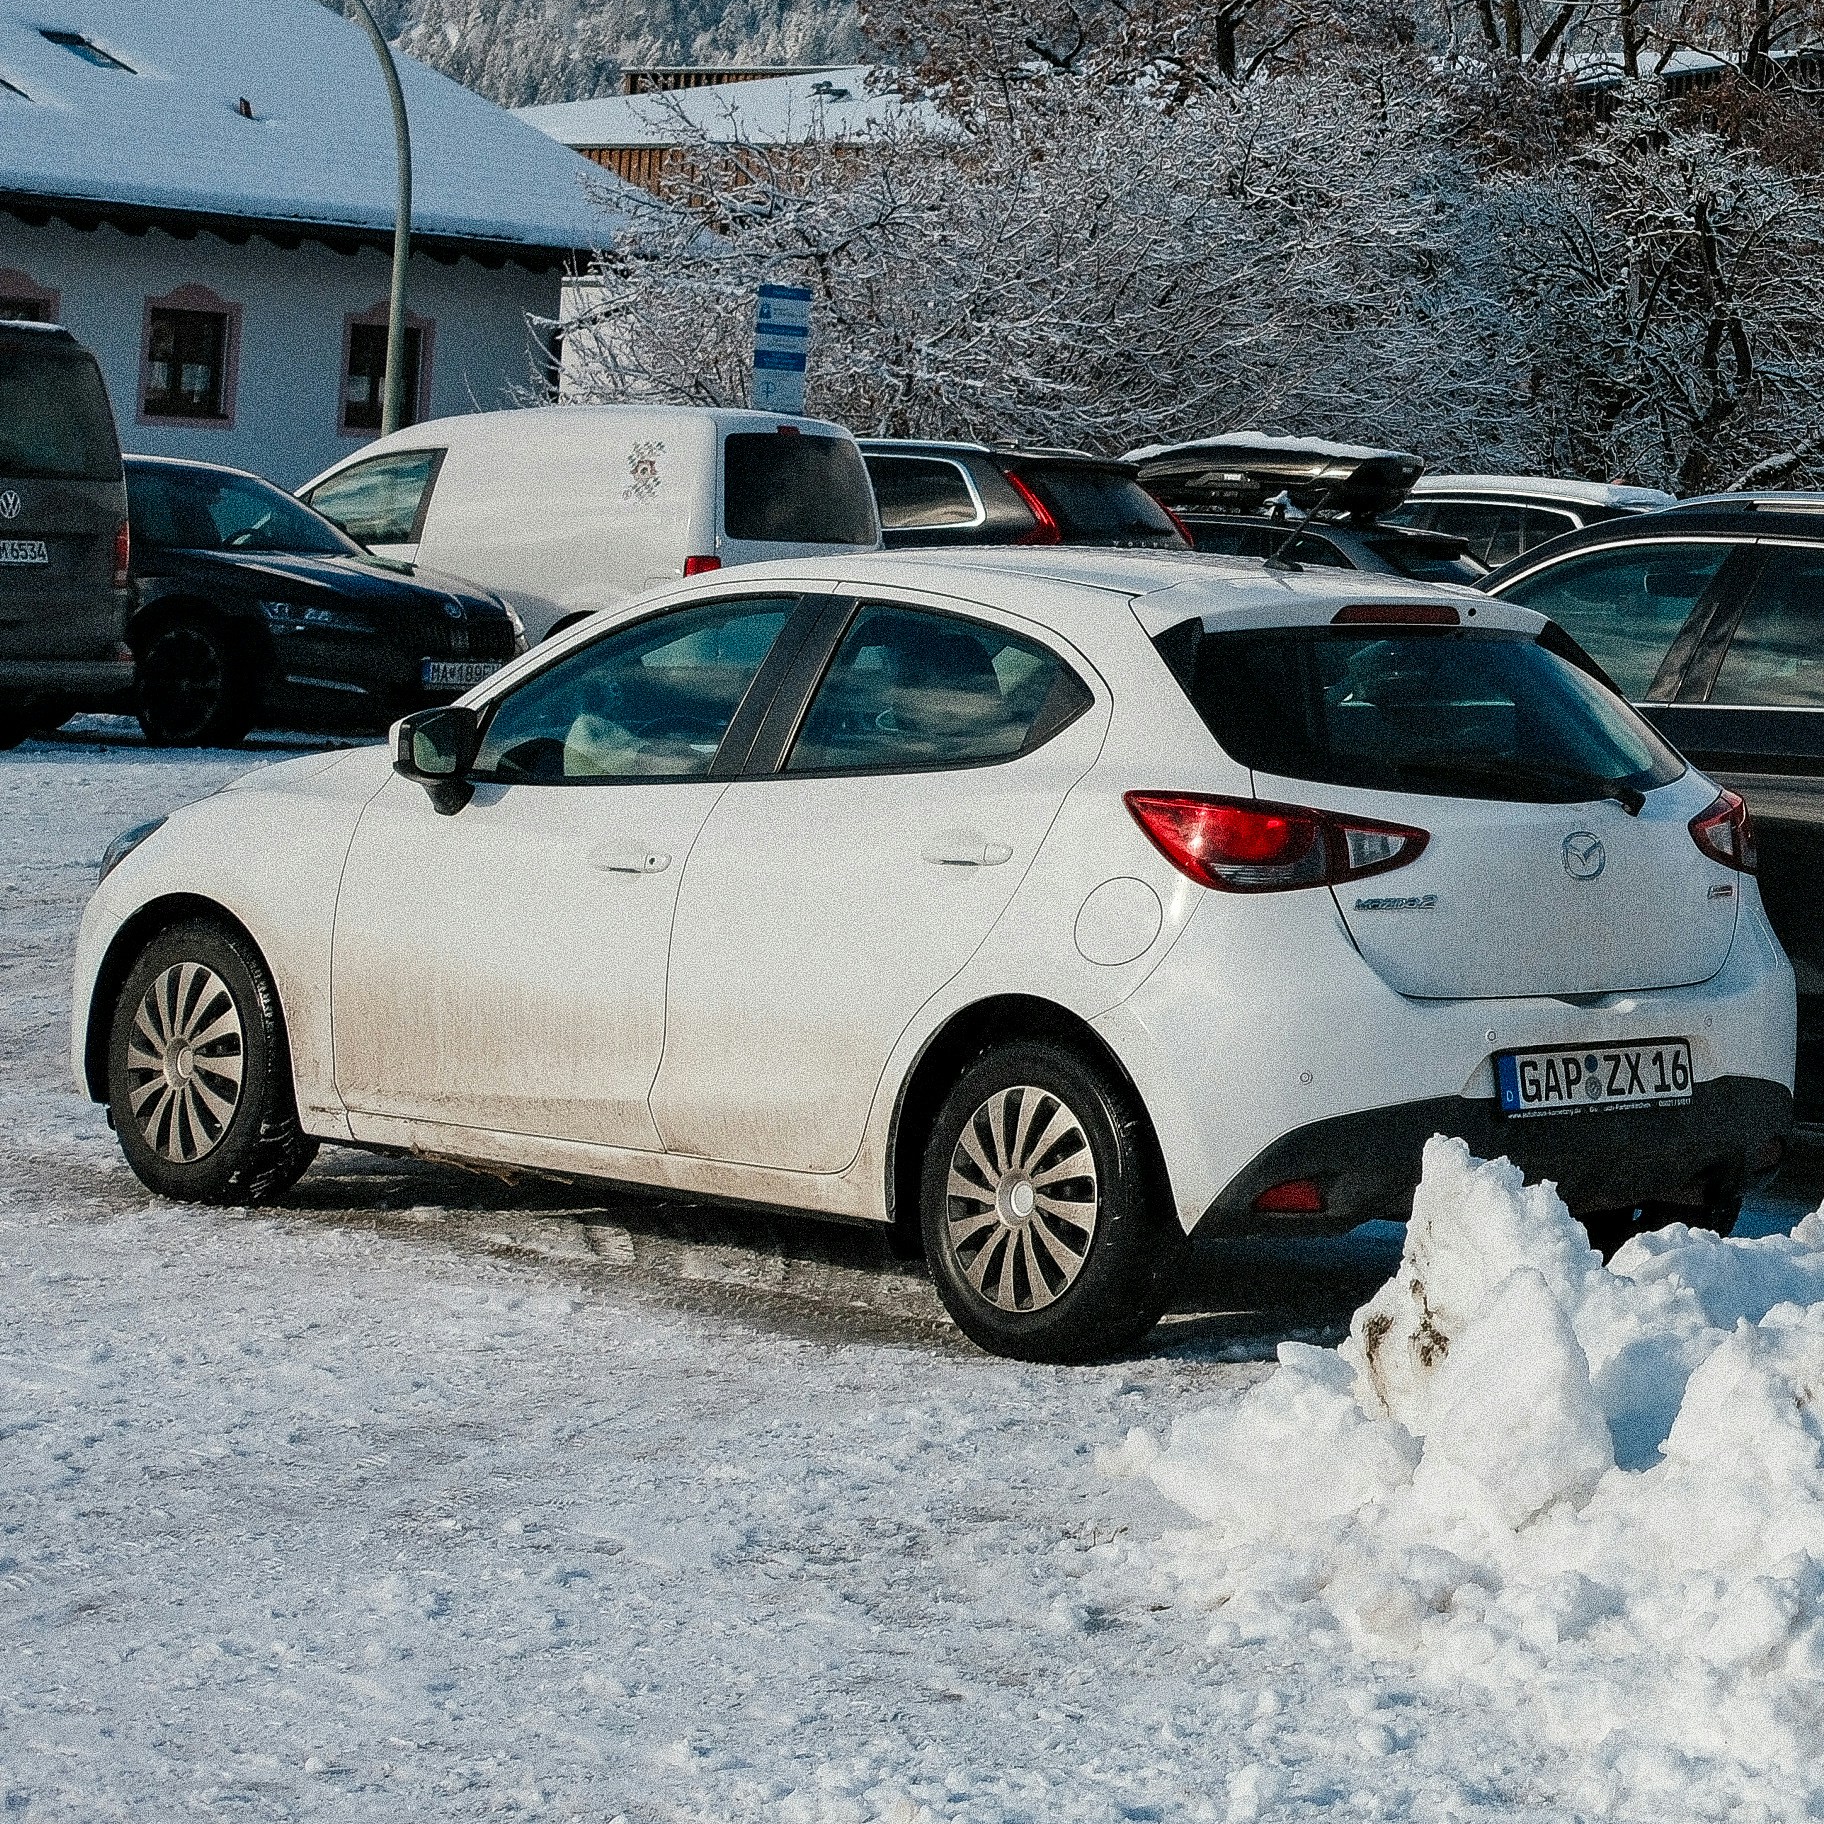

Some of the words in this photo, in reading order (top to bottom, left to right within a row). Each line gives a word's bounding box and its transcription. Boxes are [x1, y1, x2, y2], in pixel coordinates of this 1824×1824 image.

[1519, 1056, 1583, 1104] GAP
[1603, 1052, 1646, 1097] ZX
[1651, 1049, 1689, 1093] 16
